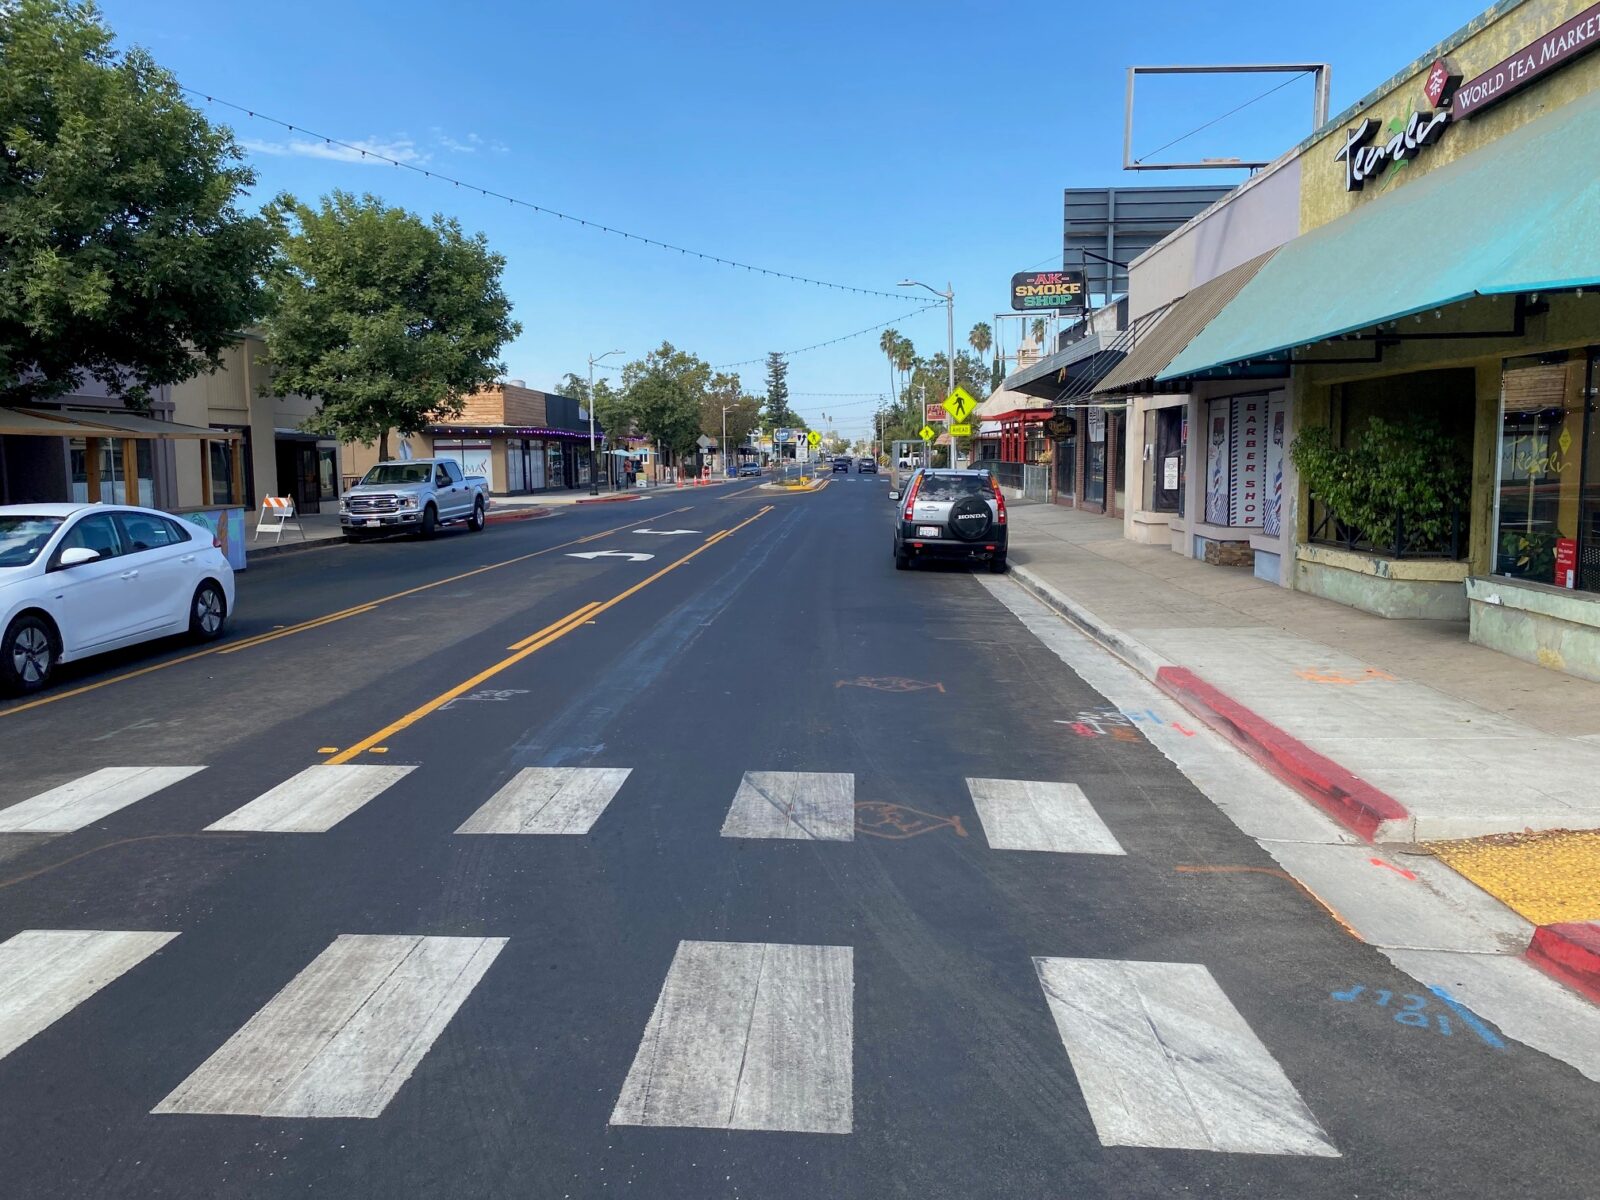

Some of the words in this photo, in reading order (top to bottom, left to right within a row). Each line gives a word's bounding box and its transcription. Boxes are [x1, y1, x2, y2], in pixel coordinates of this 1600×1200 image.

[1430, 68, 1443, 97] 茶
[1459, 72, 1505, 111] WORLD
[1508, 55, 1536, 83] TEA
[1015, 283, 1081, 297] SMOKE
[1024, 294, 1073, 307] SHOP
[952, 425, 969, 433] AHEAD
[1245, 402, 1258, 473] BARBER
[1244, 480, 1257, 525] SHOP
[957, 512, 988, 520] HONDA
